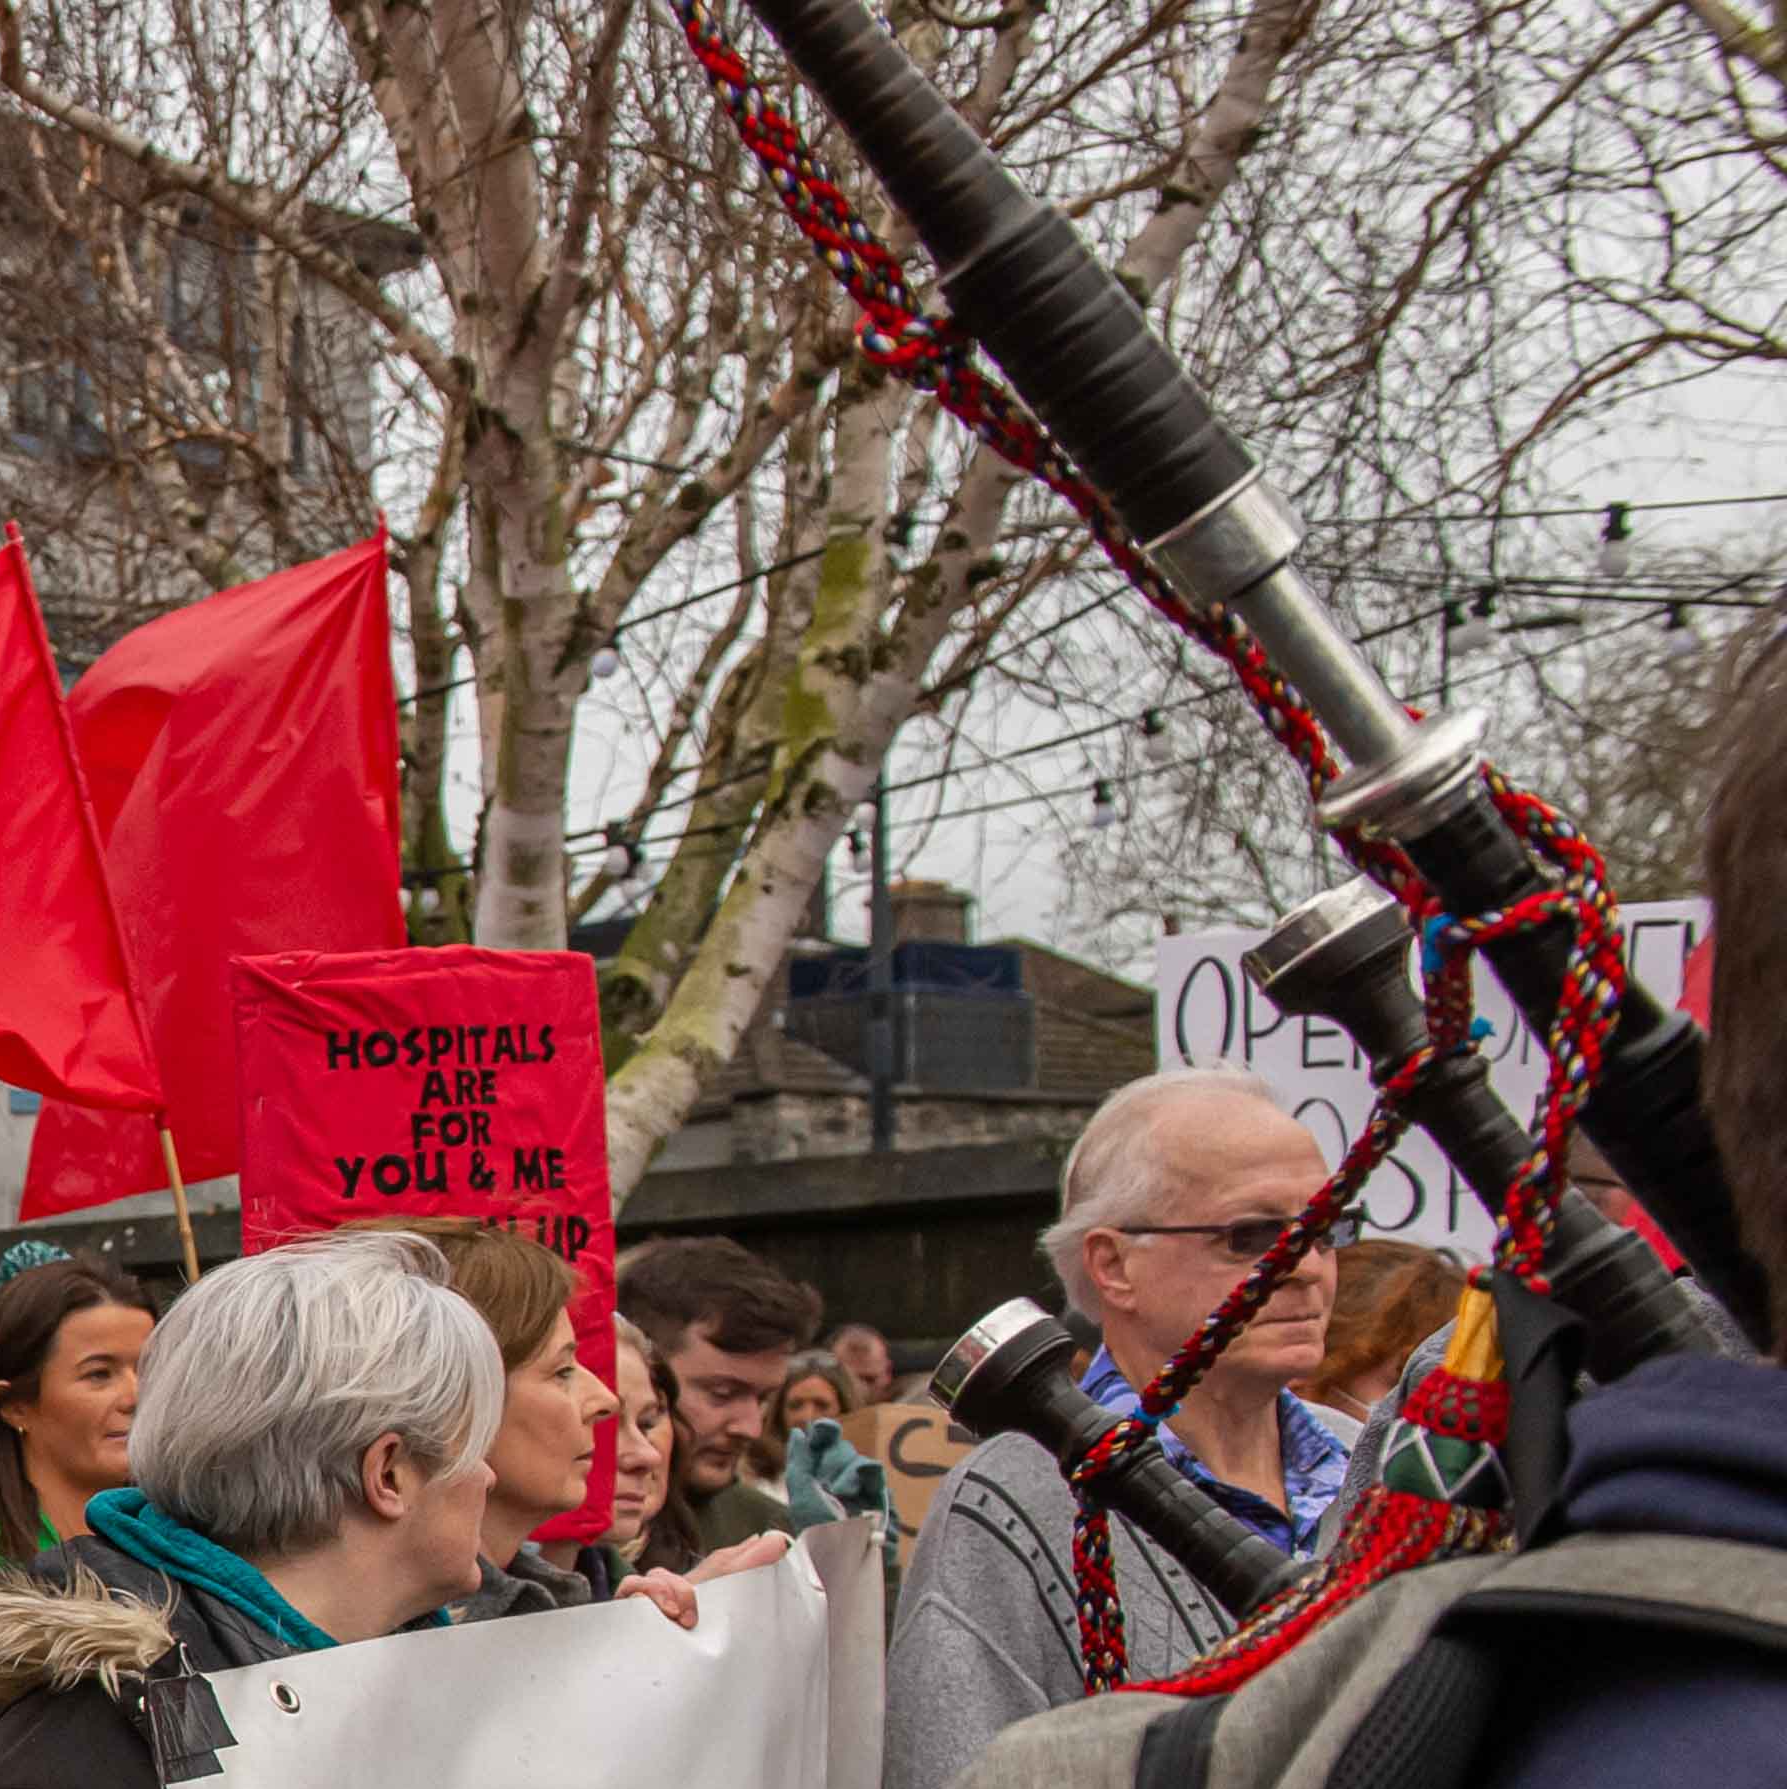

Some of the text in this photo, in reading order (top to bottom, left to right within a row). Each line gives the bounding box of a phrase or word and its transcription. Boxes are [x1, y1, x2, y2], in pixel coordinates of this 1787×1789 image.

[328, 1024, 556, 1070] HOSPITALS
[419, 1069, 498, 1108] ARE
[412, 1111, 491, 1150] FOR
[333, 1148, 567, 1199] YOU & ME
